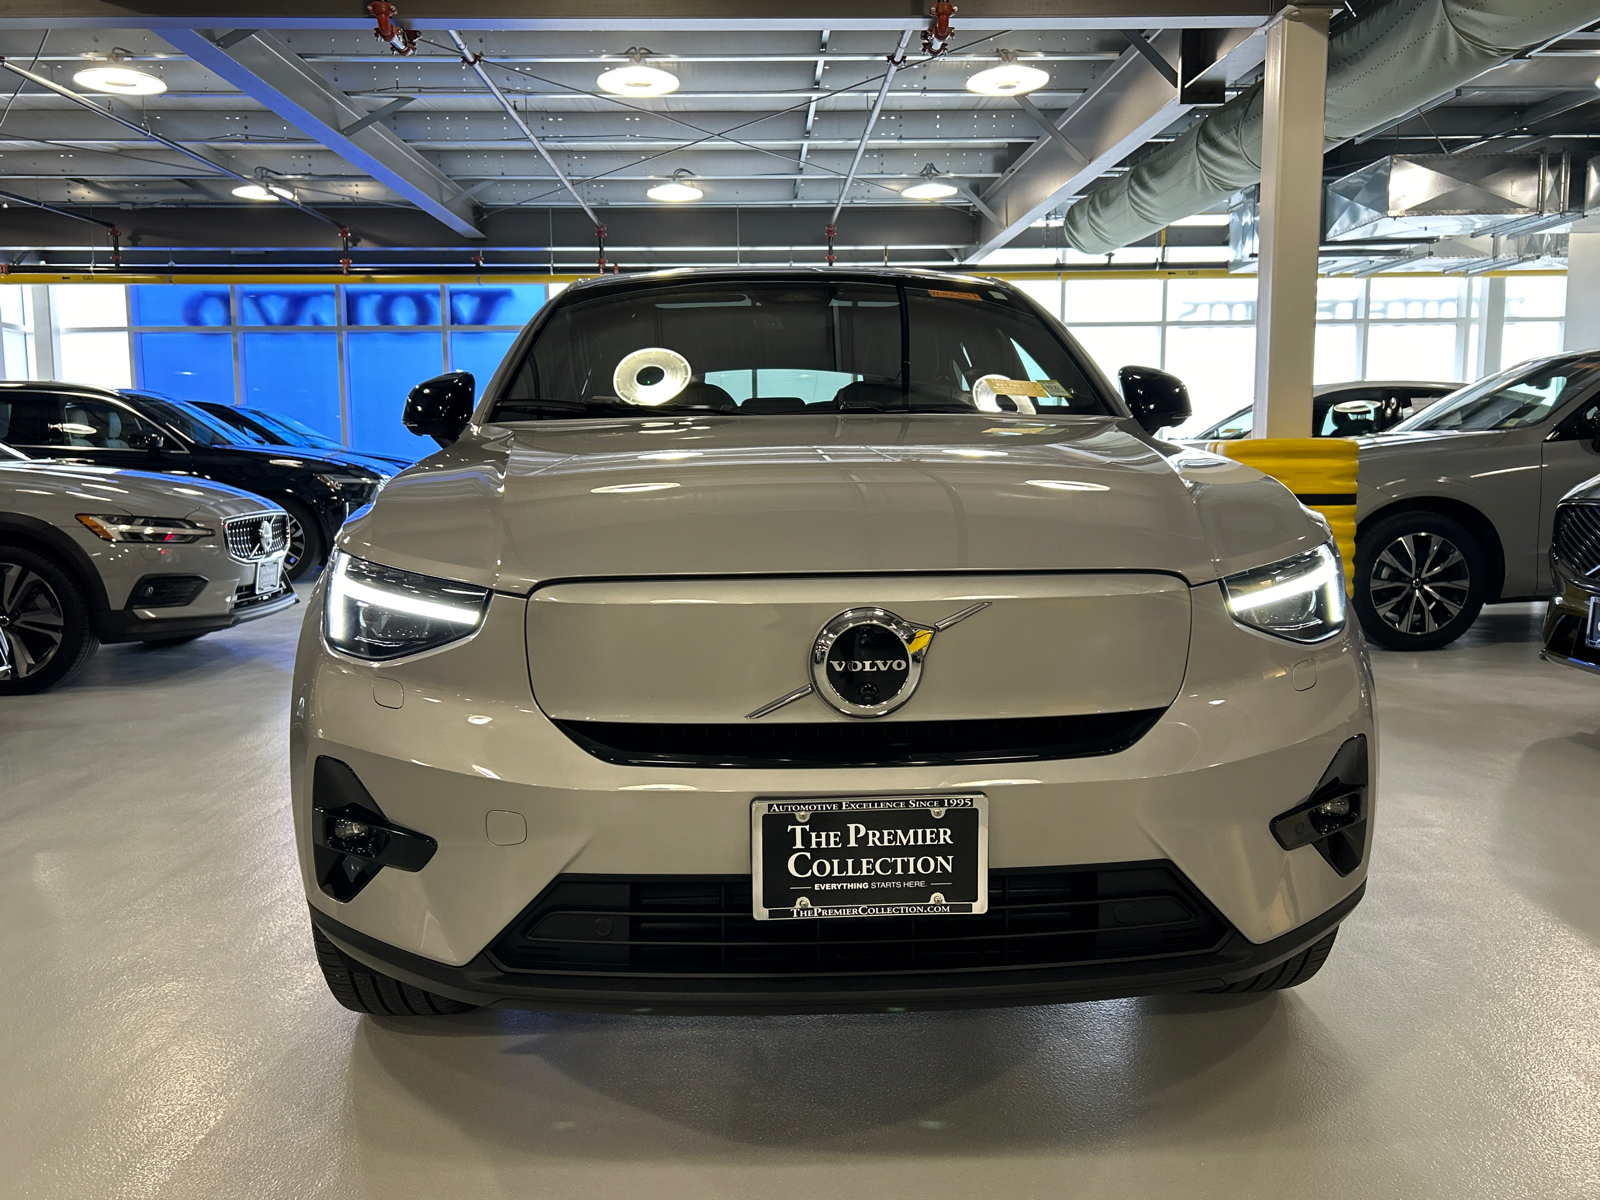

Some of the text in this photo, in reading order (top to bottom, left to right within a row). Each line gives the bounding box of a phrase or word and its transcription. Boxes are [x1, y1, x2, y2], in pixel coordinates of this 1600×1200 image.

[829, 659, 907, 672] VOLVO
[770, 798, 972, 812] AUTOMOTIVE EXCELLENCE SINCE 1995
[787, 823, 954, 849] THE PREMIER
[787, 851, 954, 878] COLLECTION
[814, 880, 928, 891] EVERYTHING STARTS HERE.
[790, 905, 951, 918] THEPREMIERCOLLECTION.COM
